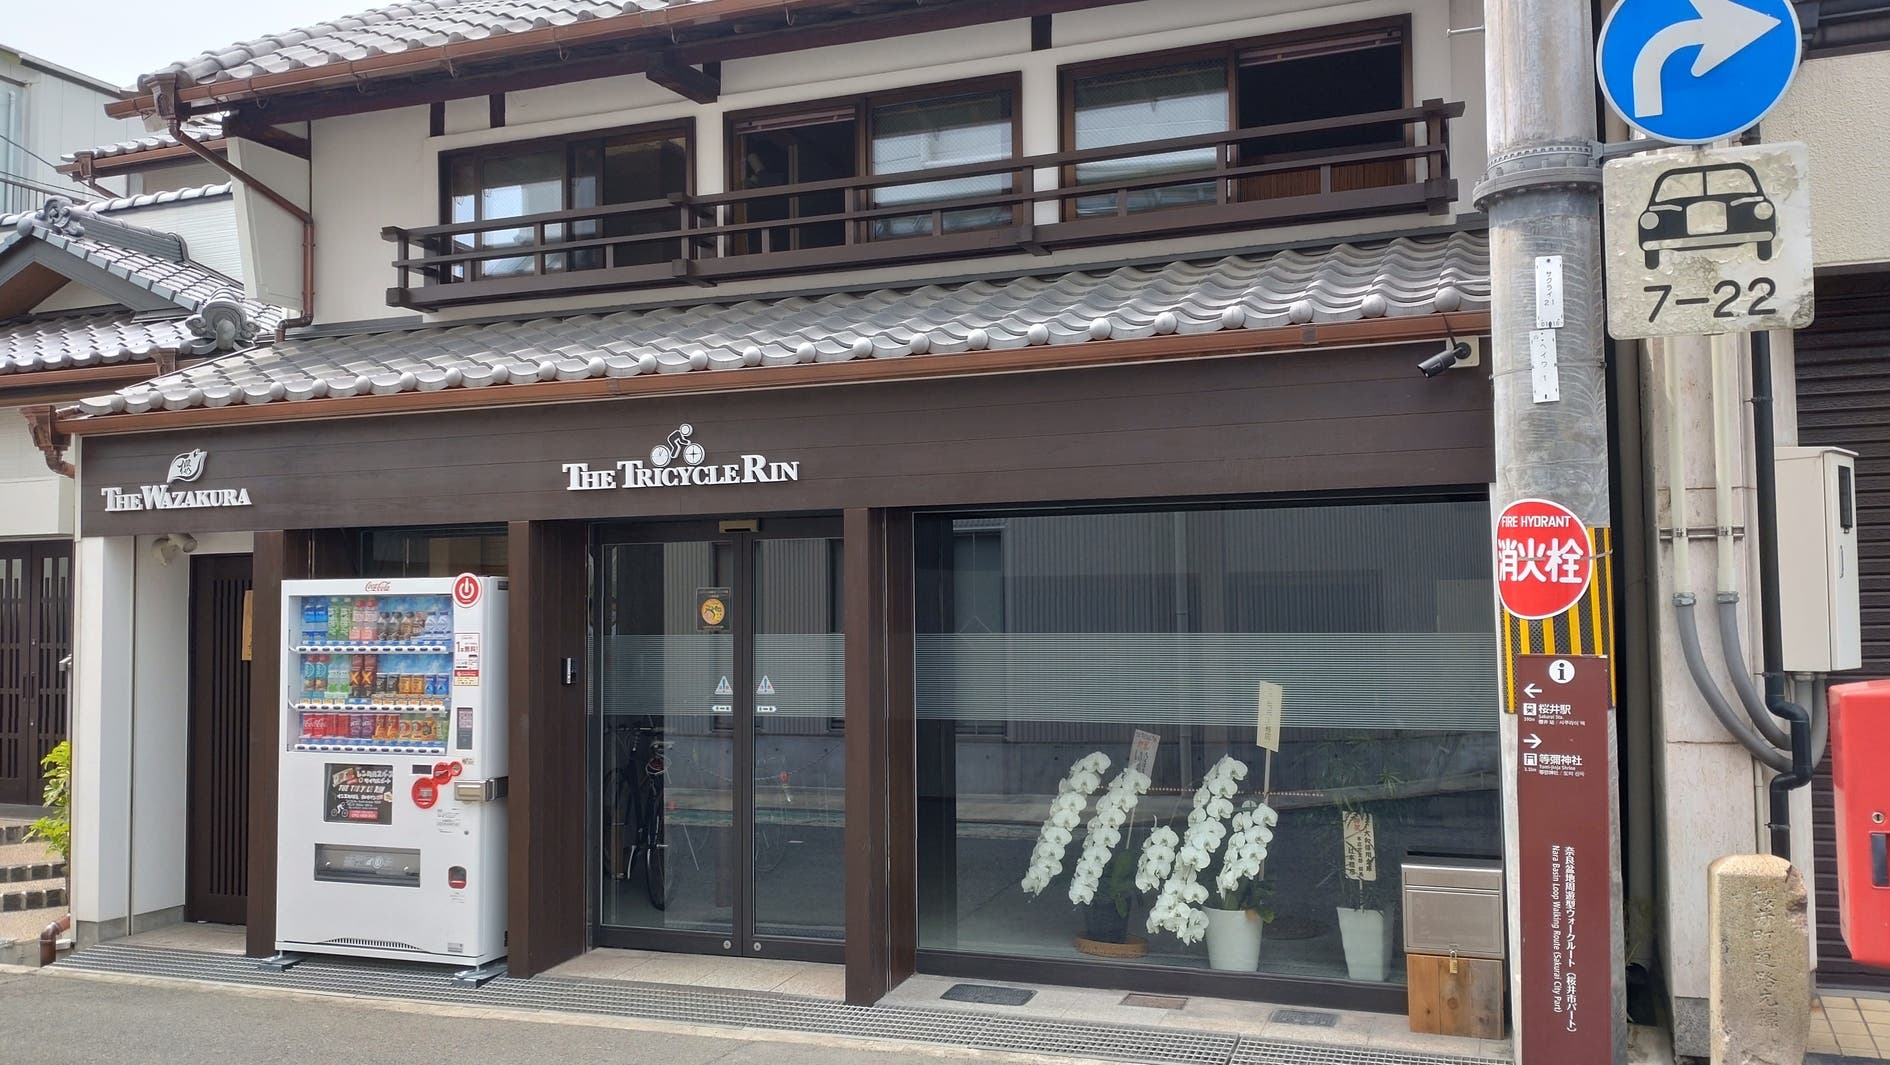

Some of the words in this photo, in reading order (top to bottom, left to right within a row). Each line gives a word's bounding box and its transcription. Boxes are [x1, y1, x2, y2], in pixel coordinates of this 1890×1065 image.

[617, 460, 741, 489] TRICYCLE
[740, 454, 800, 483] RIN
[1501, 516, 1518, 528] FIRE
[1520, 515, 1571, 528] HYDRANT
[1498, 537, 1584, 583] 消火栓
[1538, 703, 1571, 715] 桜井駅
[1551, 845, 1560, 862] Nara
[1552, 863, 1561, 882] Basin
[1551, 883, 1560, 900] Loop
[1551, 901, 1561, 929] Walking
[1553, 930, 1561, 950] Route
[1552, 981, 1562, 995] City
